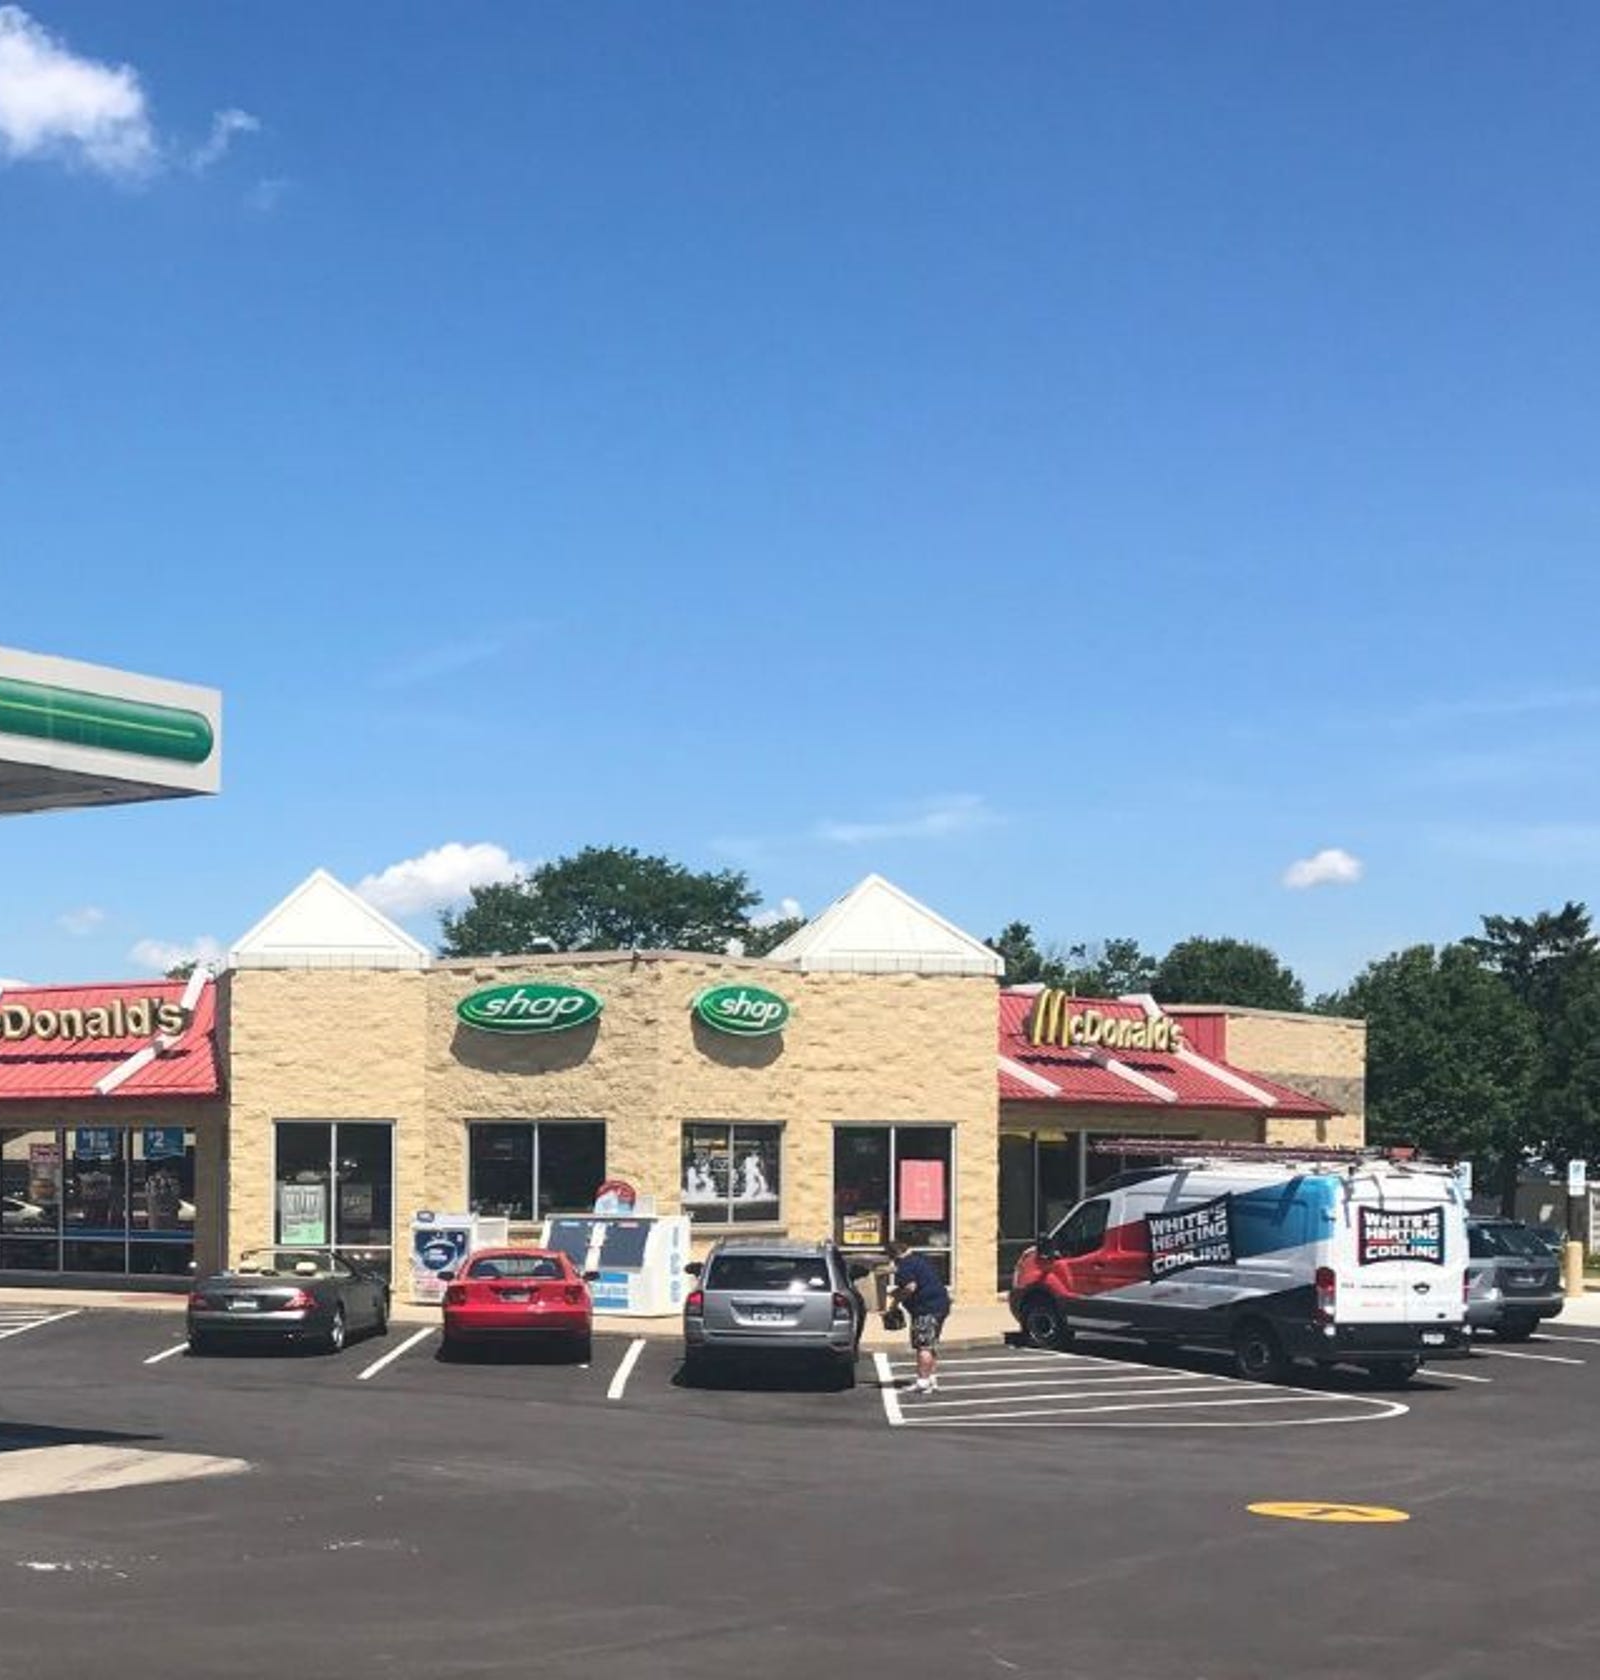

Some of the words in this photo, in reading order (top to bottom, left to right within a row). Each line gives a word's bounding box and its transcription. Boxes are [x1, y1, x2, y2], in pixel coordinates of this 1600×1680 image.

[483, 989, 585, 1024] shop
[719, 992, 782, 1028] shop
[1031, 989, 1184, 1053] McDonald's
[1149, 1202, 1227, 1236] WHITE'S
[1364, 1212, 1440, 1228] WHITE'S
[1365, 1227, 1440, 1241] HEATING
[1151, 1220, 1228, 1253] HEATING
[1365, 1244, 1440, 1259] COOLING
[1152, 1244, 1232, 1275] COOLING
